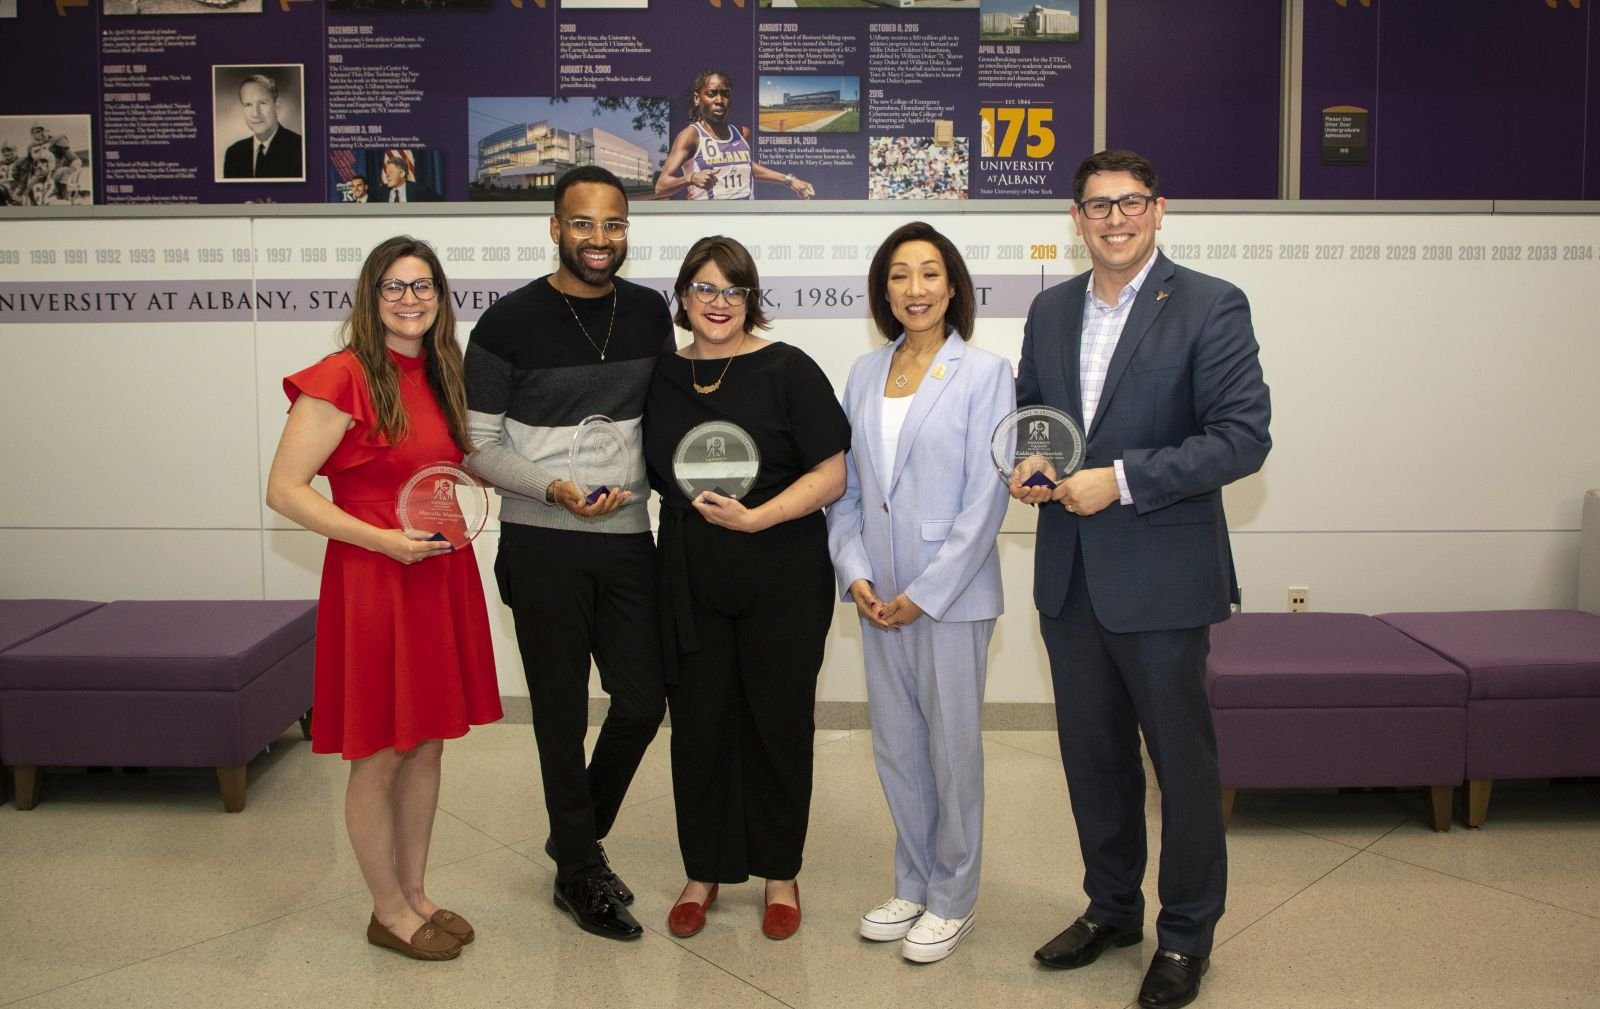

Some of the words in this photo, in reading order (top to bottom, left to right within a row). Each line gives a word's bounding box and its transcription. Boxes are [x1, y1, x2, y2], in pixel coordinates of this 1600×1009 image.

[560, 24, 576, 32] 2000
[869, 24, 896, 32] OCTOBER
[905, 24, 918, 32] 2015
[979, 46, 995, 54] APRIL
[1006, 46, 1021, 54] 2018
[560, 65, 583, 73] AUGUST
[584, 65, 594, 74] 24,
[595, 65, 611, 73] 2000
[869, 90, 883, 98] 2015
[979, 108, 1055, 159] 175
[705, 138, 717, 157] 6
[980, 161, 1054, 171] UNIVERSITY
[723, 174, 742, 189] 111
[997, 173, 1047, 186] ALBANY
[0, 251, 20, 264] 989
[31, 250, 56, 264] 1990
[64, 250, 88, 264] 1991
[96, 250, 121, 264] 1992
[130, 249, 156, 263] 1993
[164, 249, 190, 263] 1994
[198, 248, 224, 263] 1995
[267, 248, 292, 263] 1997
[301, 248, 327, 263] 1998
[336, 248, 362, 262] 1999
[447, 247, 475, 262] 2002
[482, 247, 511, 262] 2003
[518, 247, 546, 262] 2004
[628, 246, 653, 261] 2007
[768, 245, 792, 260] 2011
[799, 245, 825, 260] 2012
[832, 245, 858, 260] 2013
[966, 245, 991, 260] 2017
[998, 245, 1024, 260] 2018
[1031, 245, 1057, 260] 2019
[1171, 245, 1201, 260] 2023
[1207, 245, 1237, 260] 2024
[1243, 245, 1273, 260] 2025
[1279, 245, 1310, 260] 2026
[1315, 245, 1345, 260] 2027
[1350, 245, 1380, 260] 2028
[1386, 245, 1417, 260] 2029
[1422, 245, 1453, 260] 2030
[1459, 246, 1486, 260] 2031
[1492, 246, 1522, 260] 2032
[1528, 246, 1557, 260] 2033
[1563, 246, 1593, 260] 2034
[0, 293, 138, 311] NIVERSITY
[147, 292, 178, 311] AT
[188, 291, 298, 311] ALBANY,
[309, 291, 353, 310] STA
